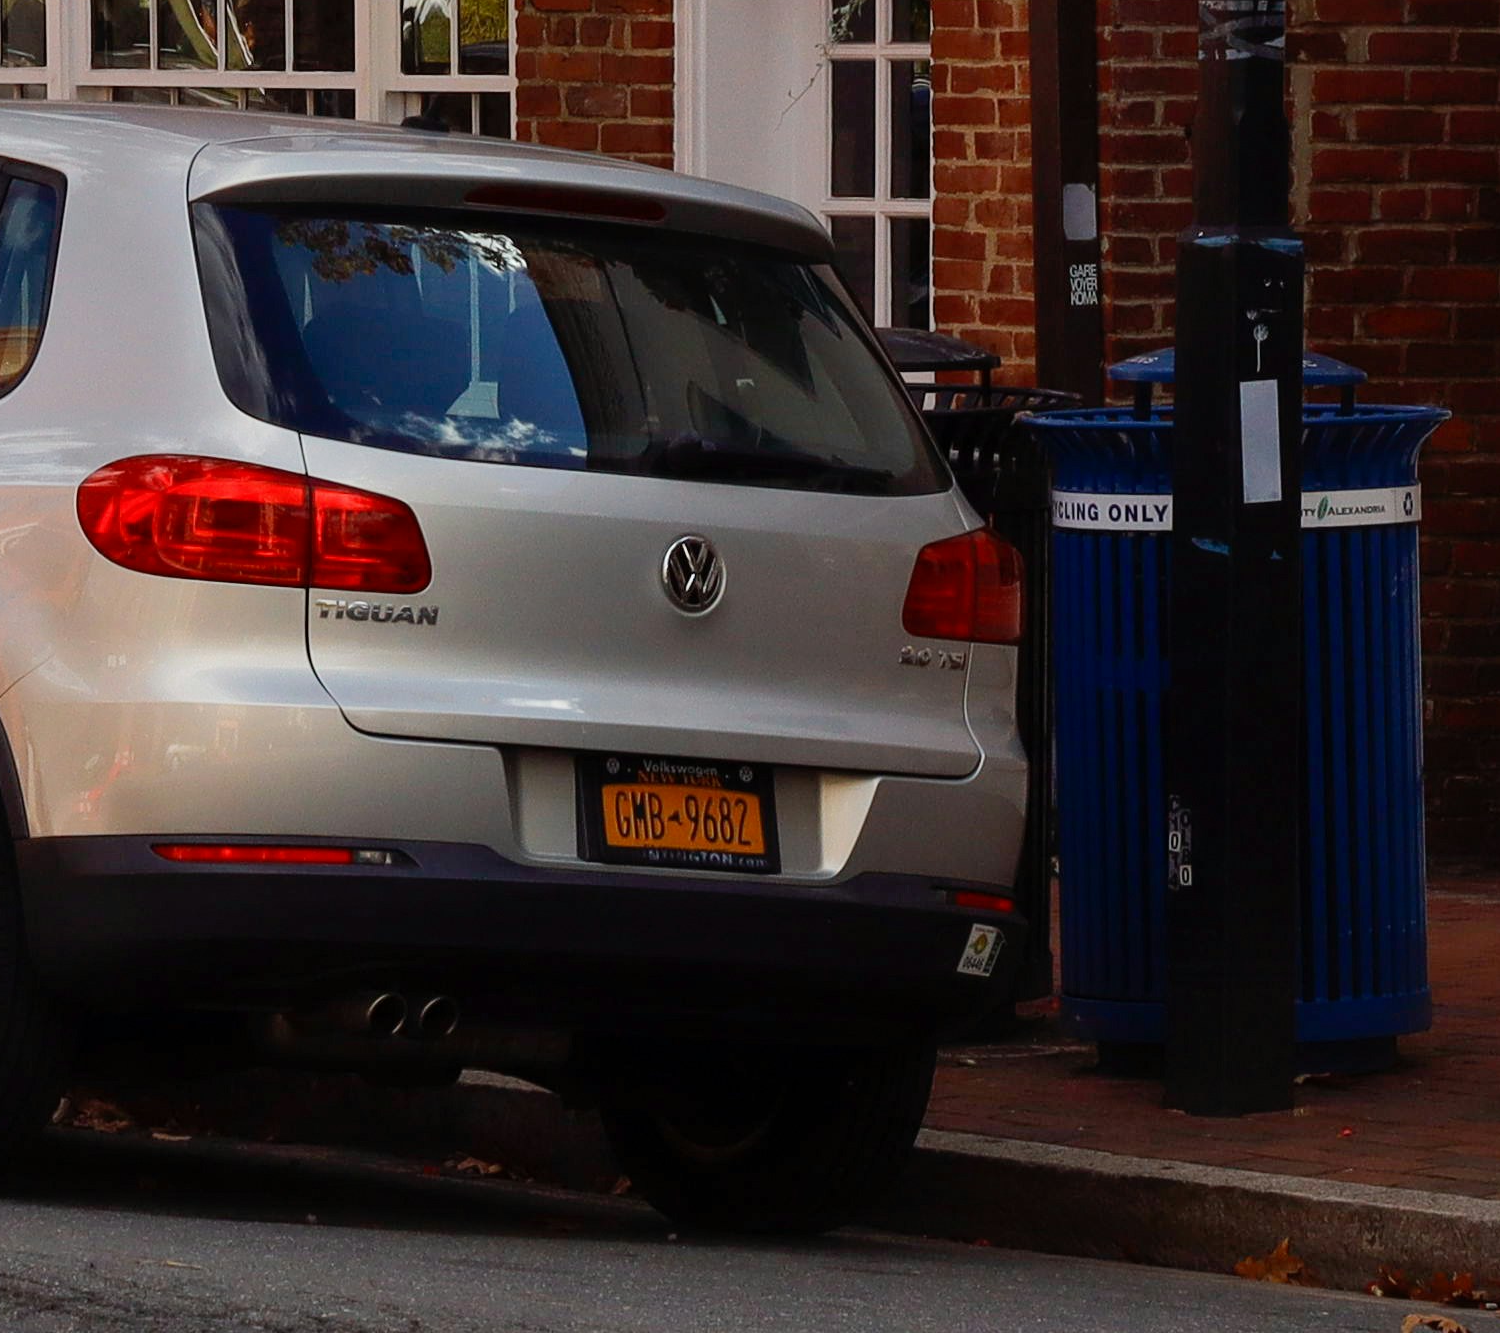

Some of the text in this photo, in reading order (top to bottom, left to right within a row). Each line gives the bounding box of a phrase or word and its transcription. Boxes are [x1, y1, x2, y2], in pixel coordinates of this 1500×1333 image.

[1070, 264, 1097, 277] GARE
[1108, 504, 1168, 523] ONLY
[315, 598, 440, 626] TIGUAN
[641, 759, 718, 777] Volkswagen
